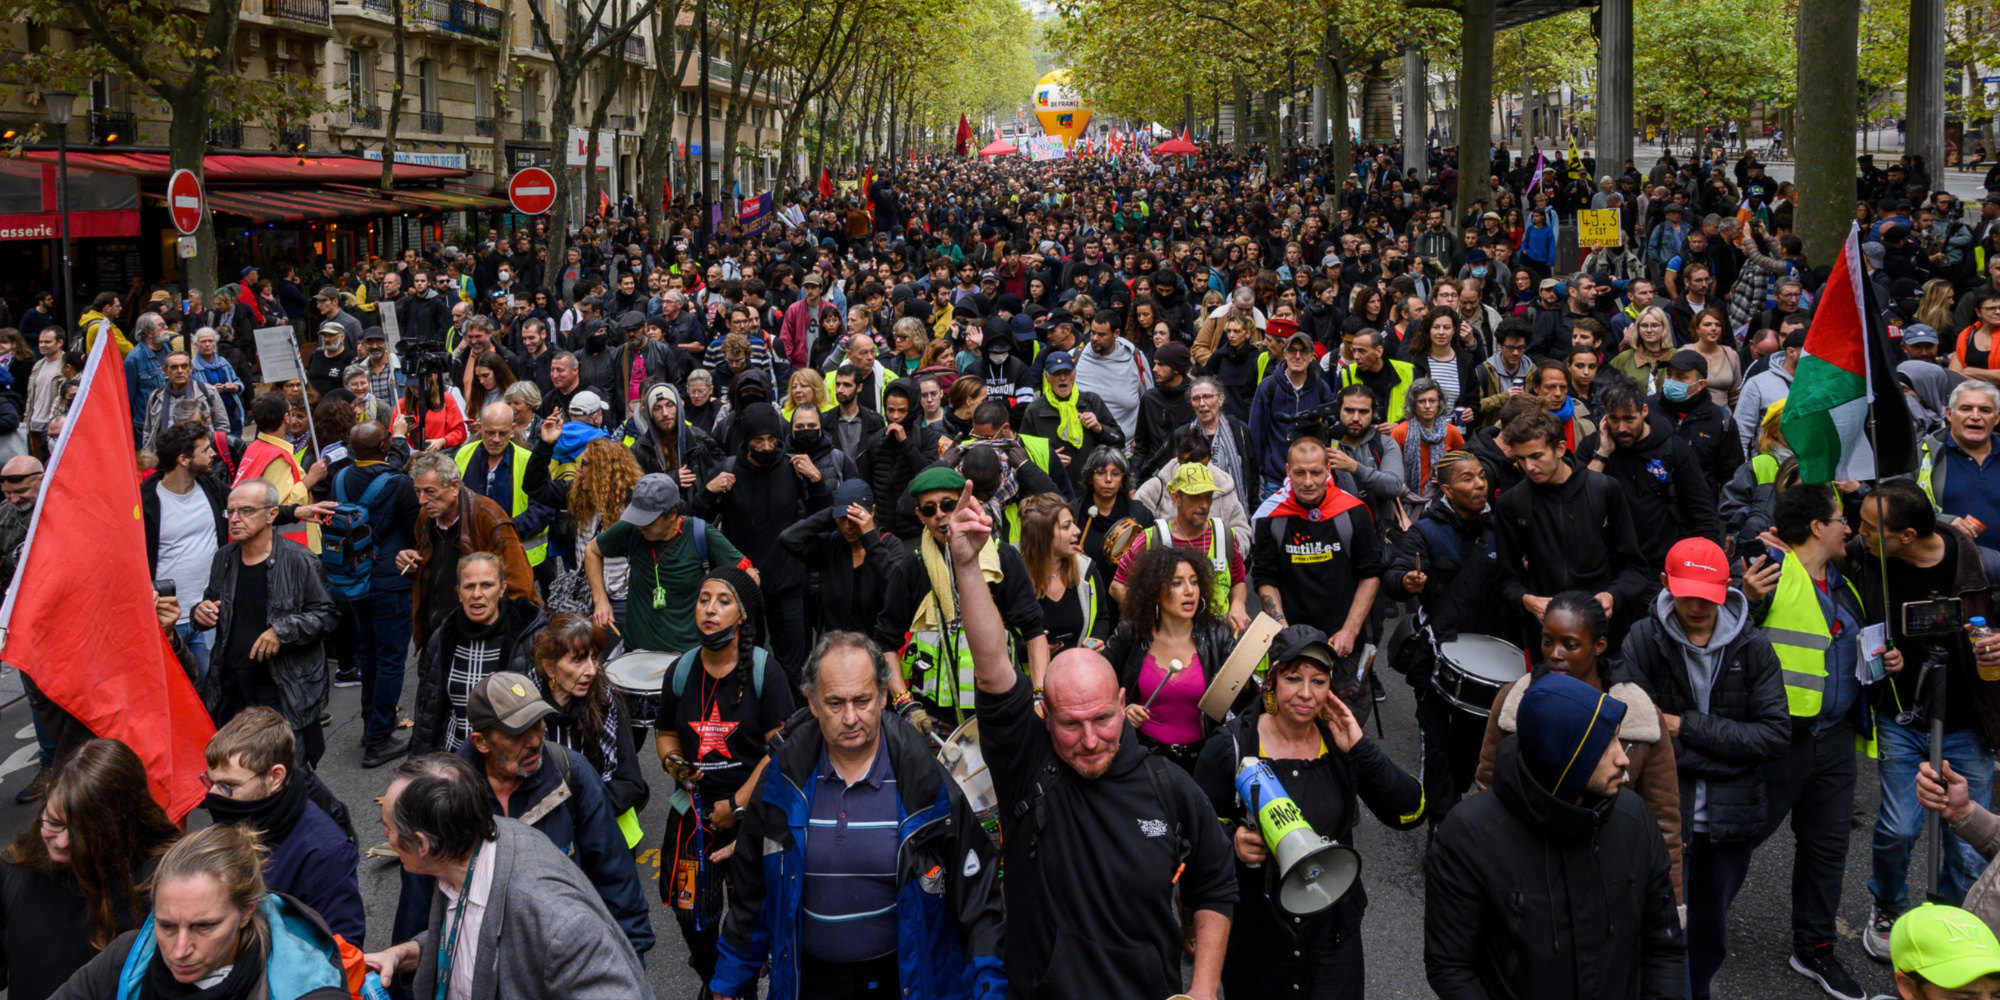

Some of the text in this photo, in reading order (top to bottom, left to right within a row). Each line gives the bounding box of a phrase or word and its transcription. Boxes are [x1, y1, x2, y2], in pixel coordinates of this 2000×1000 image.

[1581, 209, 1617, 227] 49.3
[0, 224, 53, 238] asserie
[1588, 227, 1607, 236] C'EST
[1684, 560, 1717, 572] Champion
[1935, 915, 1989, 950] NY
